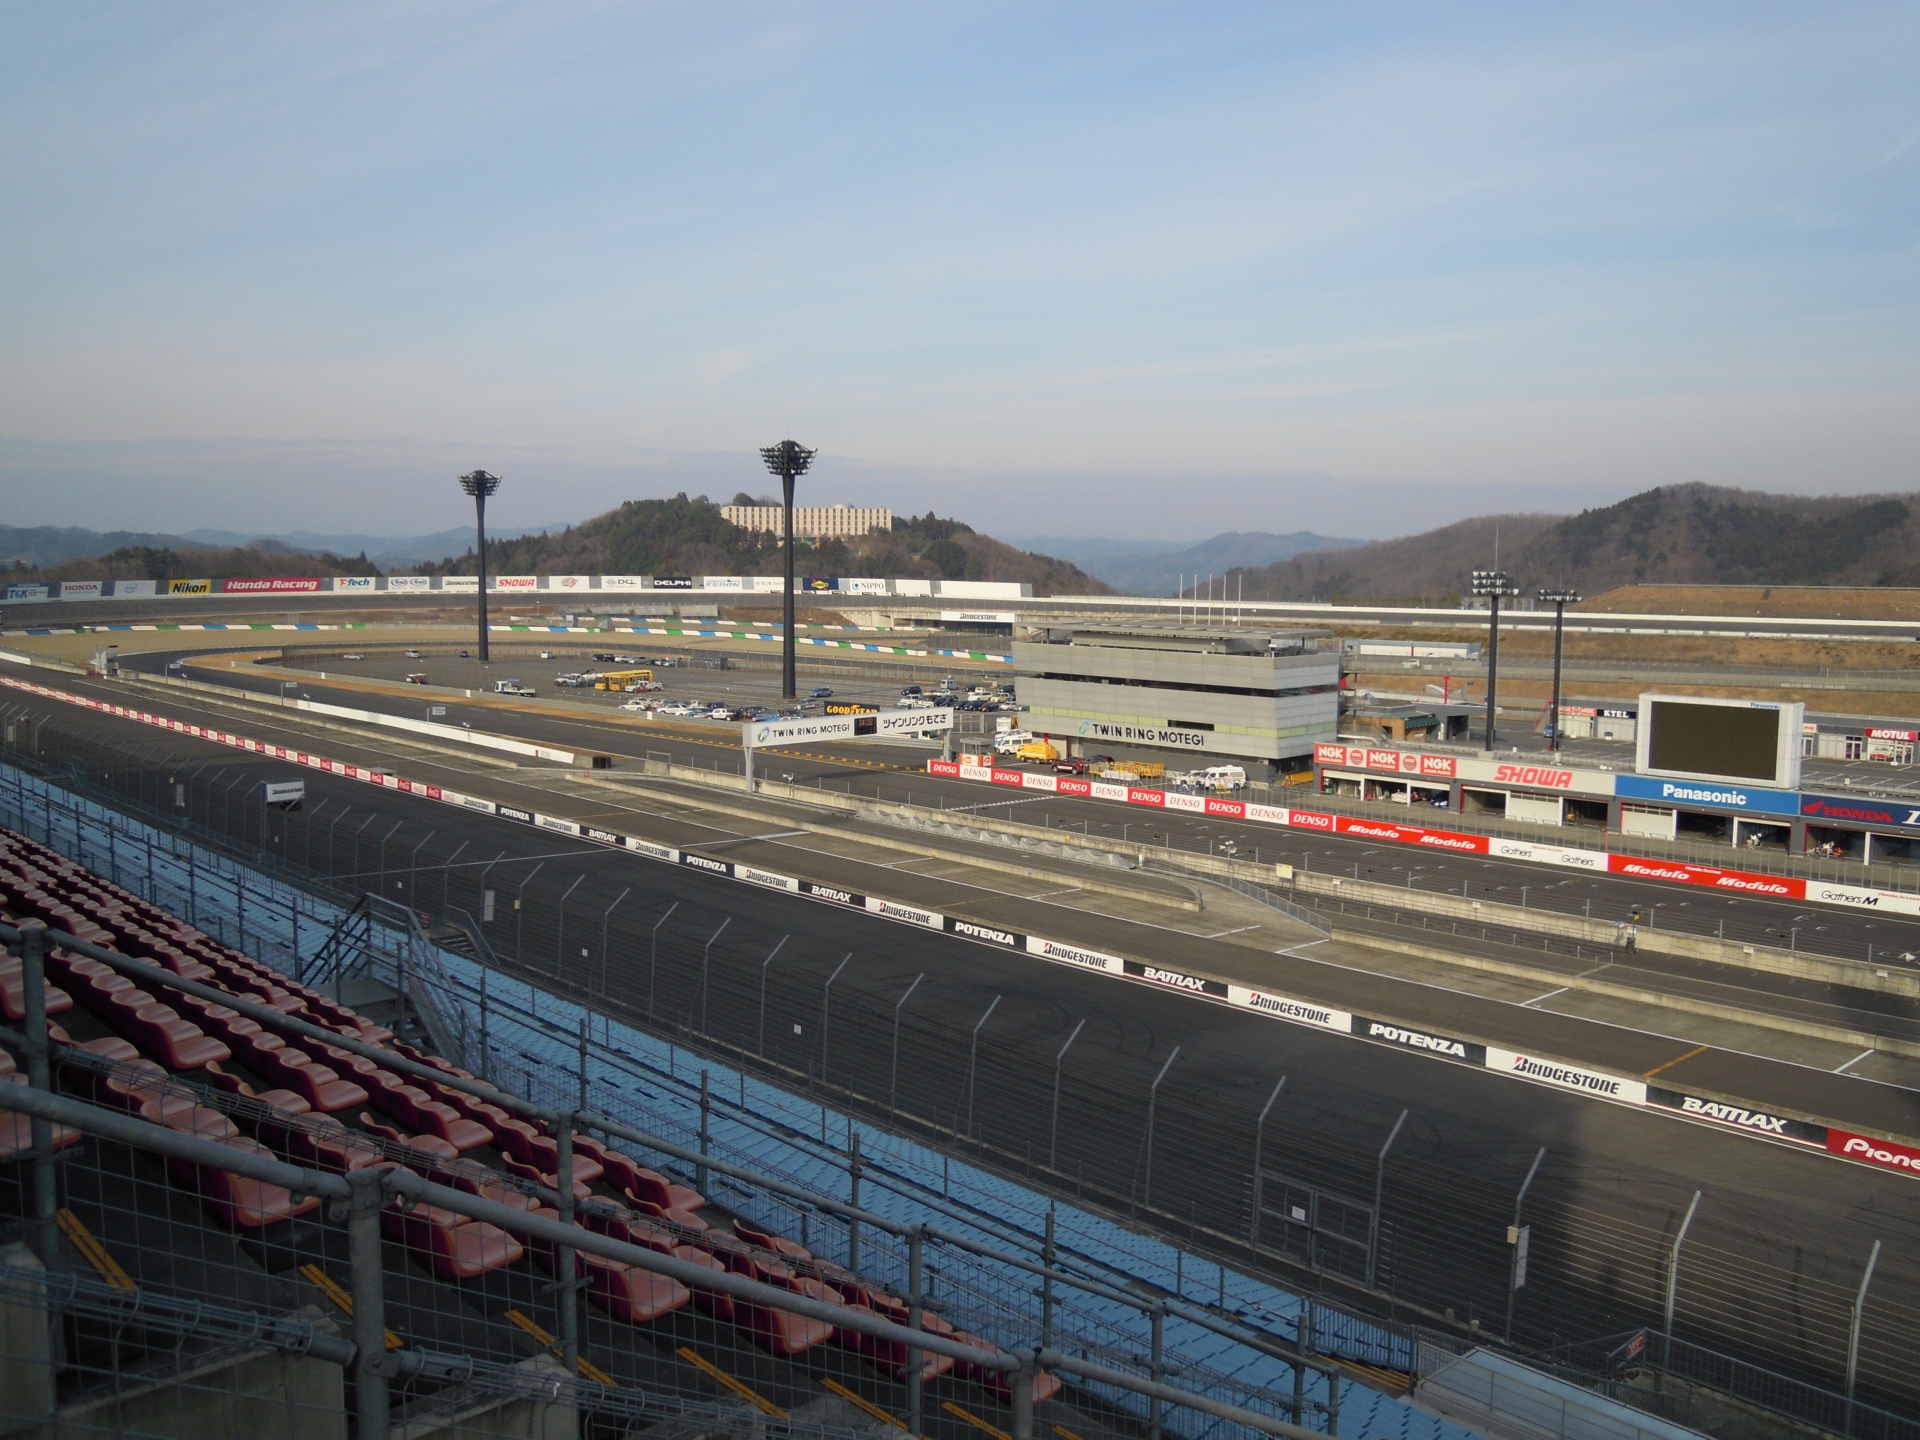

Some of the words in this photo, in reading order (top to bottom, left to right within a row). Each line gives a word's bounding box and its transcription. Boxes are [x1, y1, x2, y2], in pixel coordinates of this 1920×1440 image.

[172, 583, 207, 593] Nikon
[228, 581, 270, 589] Honda
[272, 581, 317, 590] Racing
[884, 714, 947, 729] ツインリンクもてぎ
[772, 729, 794, 738] TWIN
[797, 726, 818, 736] RING
[820, 723, 850, 733] MOTEGI
[1093, 723, 1123, 737] TWIN
[1126, 727, 1155, 740] RING
[1159, 731, 1204, 746] MOTEGI
[1871, 729, 1910, 740] MOTUL
[1318, 746, 1344, 759] NGK
[1370, 752, 1396, 764] NGK
[933, 763, 956, 774] DENSO
[1424, 757, 1452, 771] NGK
[964, 768, 987, 778] DENSO
[994, 772, 1019, 783] DENSO
[1495, 765, 1573, 788] SHOWA
[1027, 777, 1052, 787] DENSO
[1060, 781, 1087, 792] DENSO
[1095, 786, 1123, 797] DENSO
[1131, 791, 1161, 803] DENSO
[1663, 784, 1747, 806] Panasonic
[1170, 797, 1200, 808] DENSO
[1208, 802, 1241, 814] DENSO
[501, 807, 530, 821] POTENZA
[1251, 807, 1284, 820] DENSO
[1293, 814, 1329, 827] DENSO
[1823, 806, 1894, 822] HONDA
[1347, 824, 1400, 839] Modulo
[635, 841, 670, 858] BRIDGESTONE
[1420, 835, 1476, 850] Modulo
[1501, 845, 1532, 858] Gathers
[686, 855, 726, 872] POTENZA
[1562, 854, 1594, 867] Gathers
[746, 869, 788, 888] BRIDGESTONE
[1623, 864, 1690, 880] Modulo
[1716, 877, 1788, 895] Modulo
[880, 902, 931, 924] BRIDGESTONE
[955, 921, 1014, 945] POTENZA
[1044, 942, 1108, 968] BRIDGESTONE
[1249, 992, 1331, 1024] BRIDGESTONE
[1370, 1023, 1465, 1057] POTENZA
[1512, 1056, 1621, 1095] BRIDGESTONE
[1682, 1096, 1788, 1133] BATTLAX
